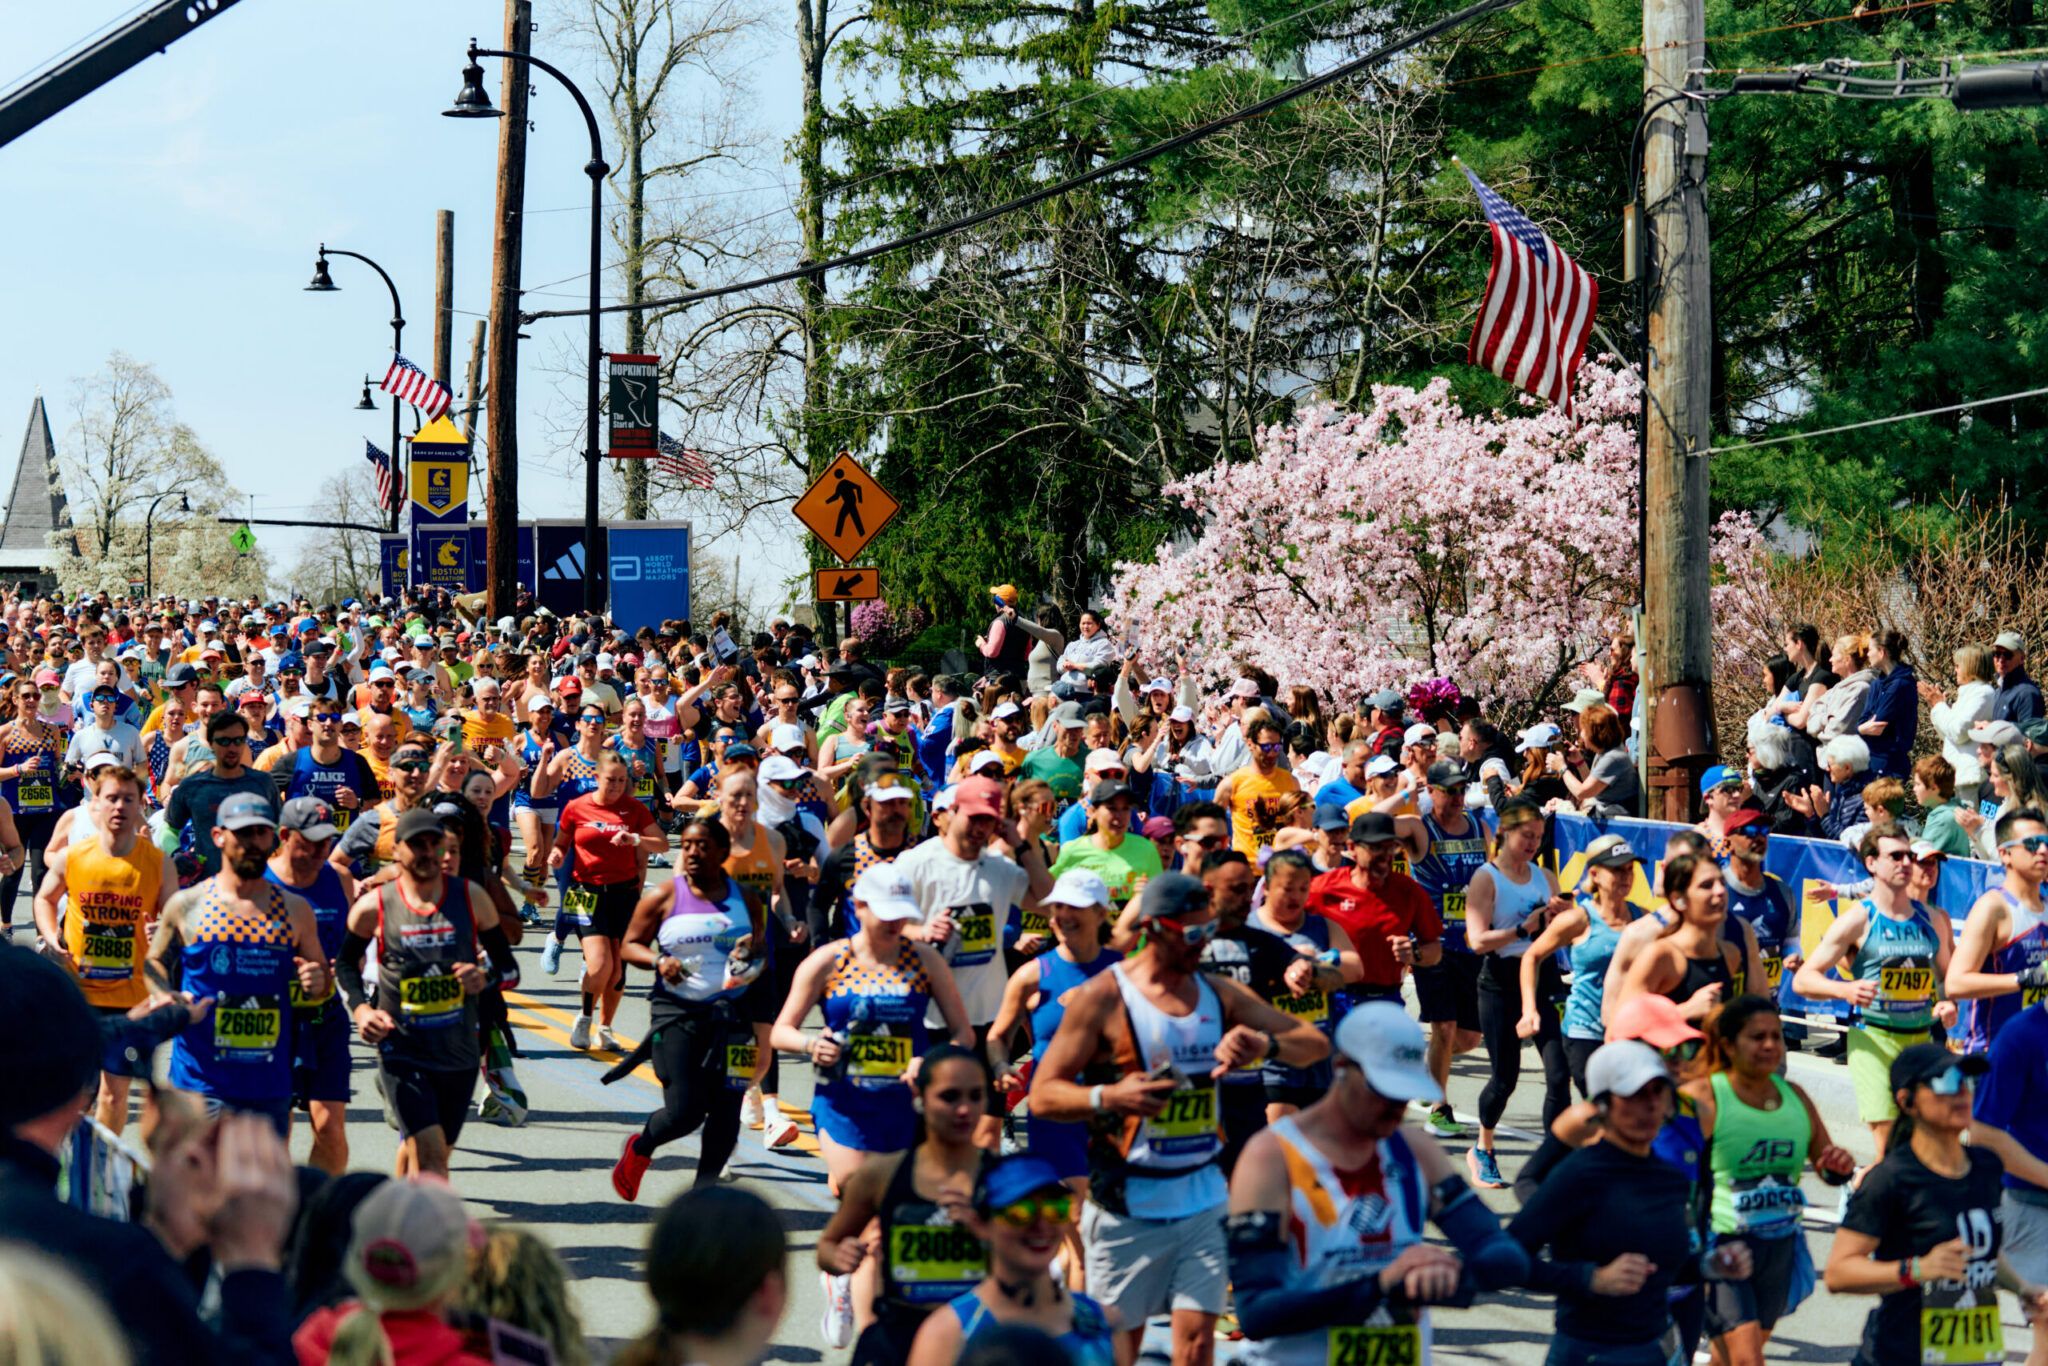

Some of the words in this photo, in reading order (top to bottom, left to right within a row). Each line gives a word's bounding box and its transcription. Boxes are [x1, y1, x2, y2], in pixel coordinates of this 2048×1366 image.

[611, 364, 658, 377] HOPKINTON
[613, 412, 624, 420] The
[613, 421, 626, 429] Start
[626, 421, 634, 429] of
[432, 568, 465, 576] BOSTON
[311, 772, 346, 782] JAKE
[21, 788, 51, 801] 26565
[79, 891, 143, 908] STEPPING
[81, 905, 141, 921] STRONG
[84, 936, 133, 959] 26888
[1884, 971, 1930, 990] 27497
[408, 979, 460, 1003] 28689
[221, 1011, 275, 1036] 26602
[851, 1039, 905, 1064] 26531
[1153, 1094, 1211, 1123] 7271
